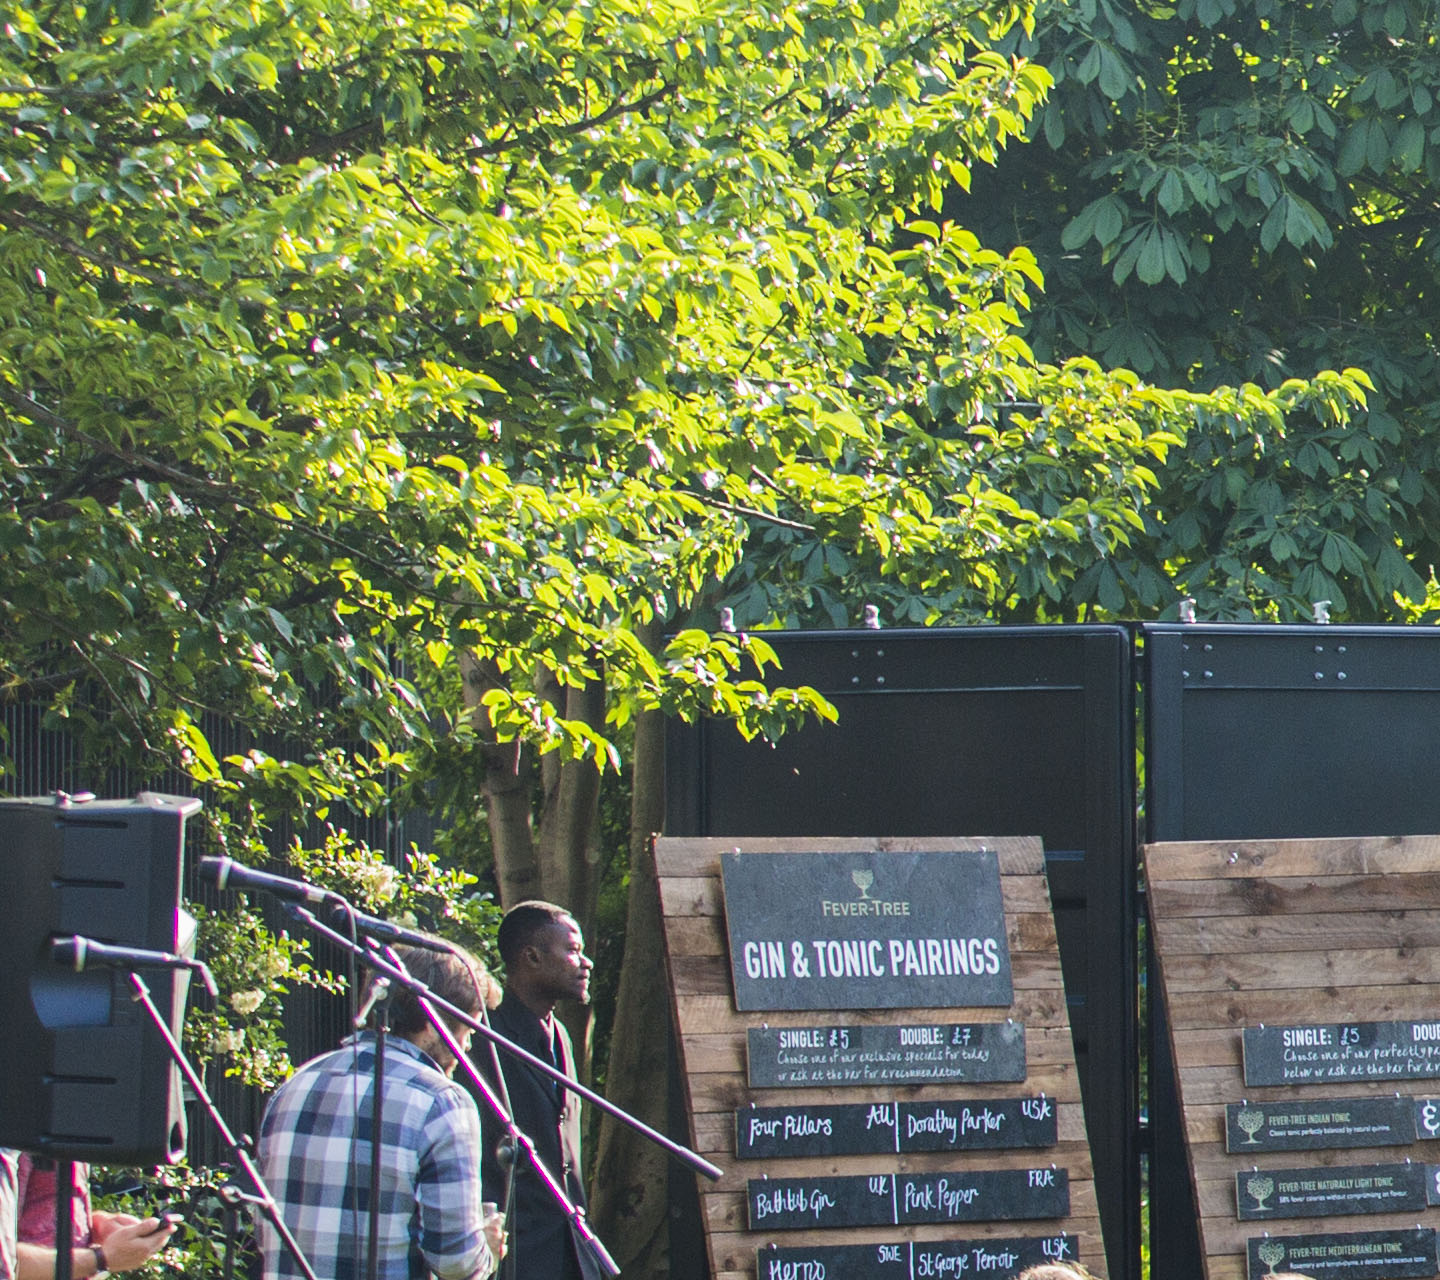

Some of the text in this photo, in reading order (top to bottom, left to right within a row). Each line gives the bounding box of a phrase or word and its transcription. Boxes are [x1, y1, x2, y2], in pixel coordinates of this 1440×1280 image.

[822, 900, 911, 916] FEVER-TREE
[744, 938, 1001, 979] GIN & TONIC PAIRINGS
[779, 1029, 849, 1049] SINGLE: £5
[900, 1026, 971, 1046] DOUBLE: £7
[1283, 1027, 1360, 1047] SINGLE: £5
[777, 1050, 808, 1064] Choose
[961, 1047, 990, 1062] today
[1284, 1048, 1319, 1062] Choose
[1374, 1041, 1425, 1060] perfectly
[1284, 1066, 1313, 1078] below
[1022, 1099, 1052, 1121] USA
[1269, 1112, 1351, 1126] FEVER-TREE INDIAN TONIC
[750, 1114, 833, 1146] Four Pillars
[961, 1107, 1006, 1136] Parker
[869, 1177, 889, 1196] UK
[1279, 1176, 1394, 1193] FEVER-TREE NATURALLY LIGHT TONIC
[757, 1189, 836, 1219] Bathtub Gin
[904, 1179, 980, 1218] Pink Pepper
[878, 1244, 903, 1263] SWE
[1042, 1238, 1071, 1261] USA
[1289, 1242, 1402, 1259] FEVER-TREE MEDITERRANEAN TONIC
[935, 1253, 969, 1279] George
[972, 1247, 1019, 1272] Terroir
